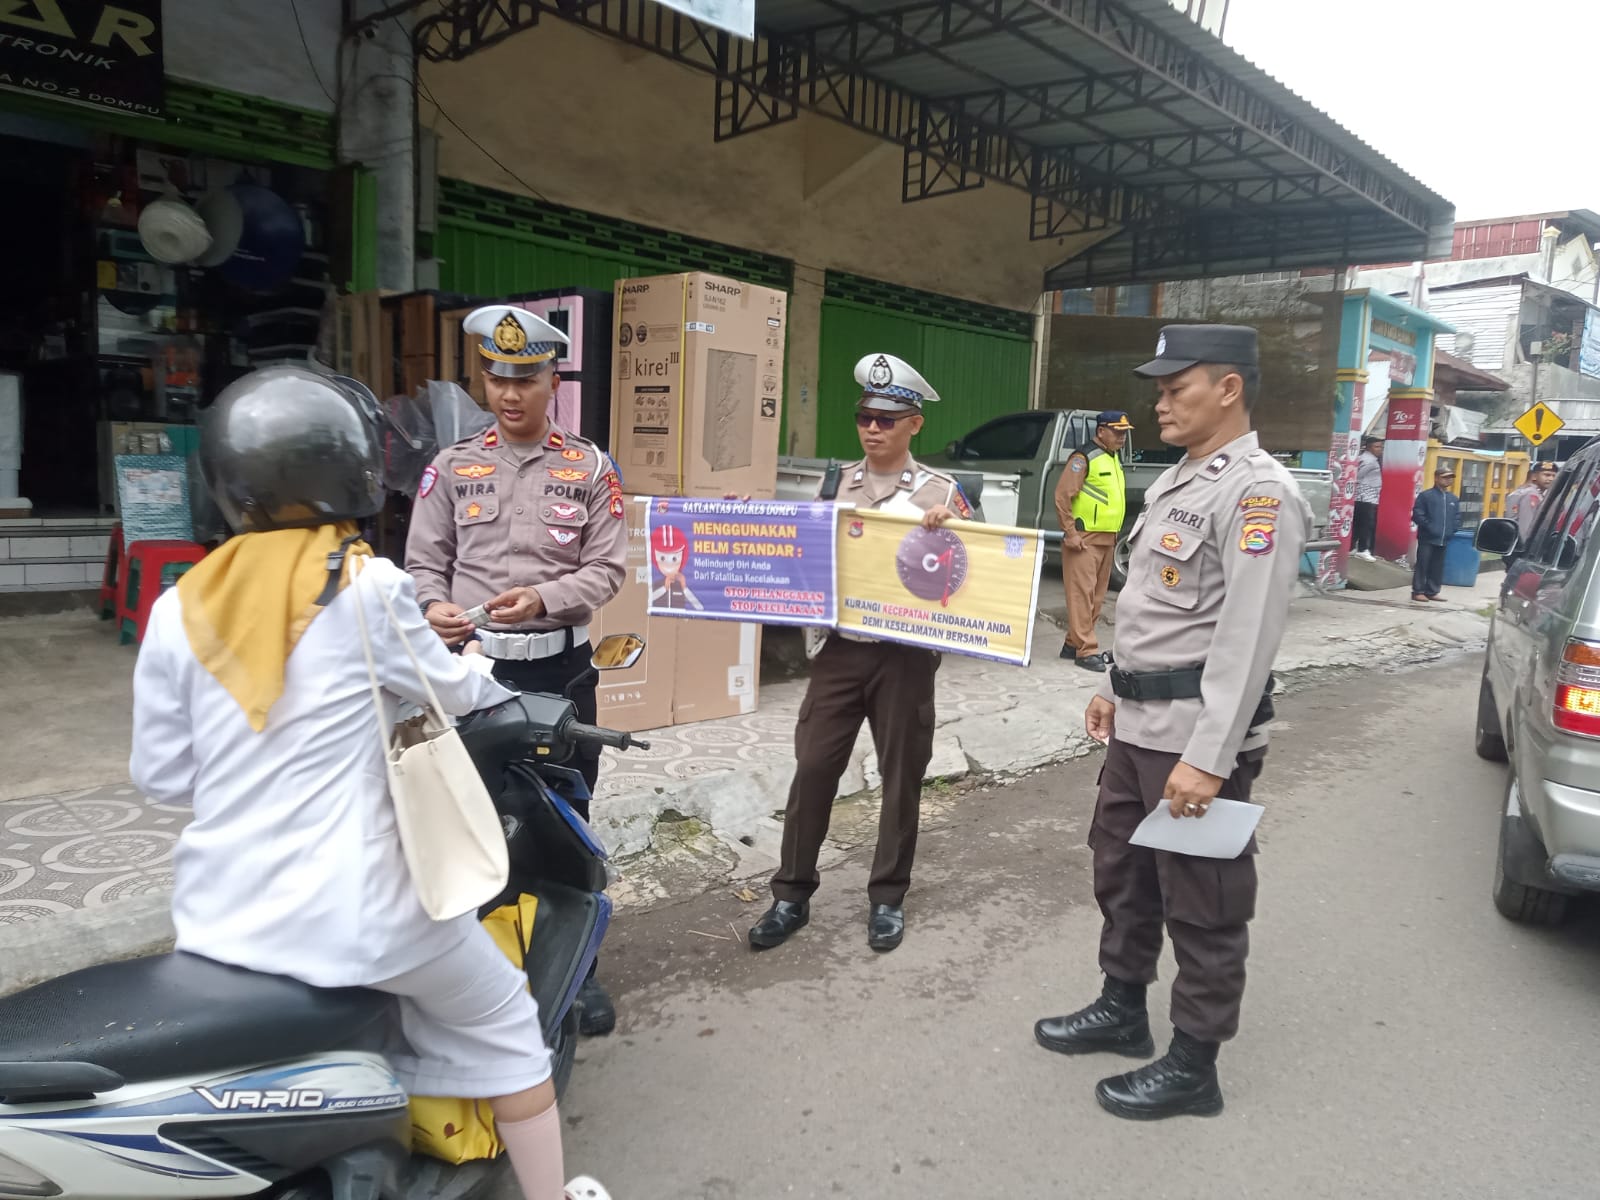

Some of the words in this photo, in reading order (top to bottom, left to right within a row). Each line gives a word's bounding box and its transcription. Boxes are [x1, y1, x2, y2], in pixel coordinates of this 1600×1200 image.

[22, 77, 80, 97] NO.2
[88, 93, 160, 114] DOMPU
[705, 281, 741, 296] SHARP
[635, 358, 668, 376] kirei
[455, 484, 496, 498] WIRA
[544, 484, 586, 501] POLRI
[683, 502, 731, 514] SATLANTAS
[732, 504, 765, 515] POLRES
[766, 505, 798, 516] DOMPU
[1168, 508, 1205, 529] POLRI
[693, 522, 797, 538] MENGGUNAKAN
[694, 541, 729, 555] HELM
[732, 543, 795, 557] STANDAR
[694, 558, 735, 570] Melindungi
[736, 560, 749, 568] Diri
[751, 561, 771, 570] Anda
[694, 571, 709, 580] Dari
[745, 573, 790, 584] Kecelakaan
[724, 586, 750, 598] STOP
[751, 588, 824, 602] PELANGGARAN
[731, 600, 756, 612] STOP
[757, 602, 824, 616] KECELAKAAN
[845, 598, 880, 612] KURANGI
[882, 605, 929, 620] KECEPATAN
[931, 613, 985, 630] KENDARAAN
[987, 622, 1011, 635] ANDA
[862, 616, 882, 628] DEMI
[884, 619, 944, 638] KESELAMATAN
[946, 631, 988, 647] BERSAMA
[190, 1086, 324, 1109] VARIO
